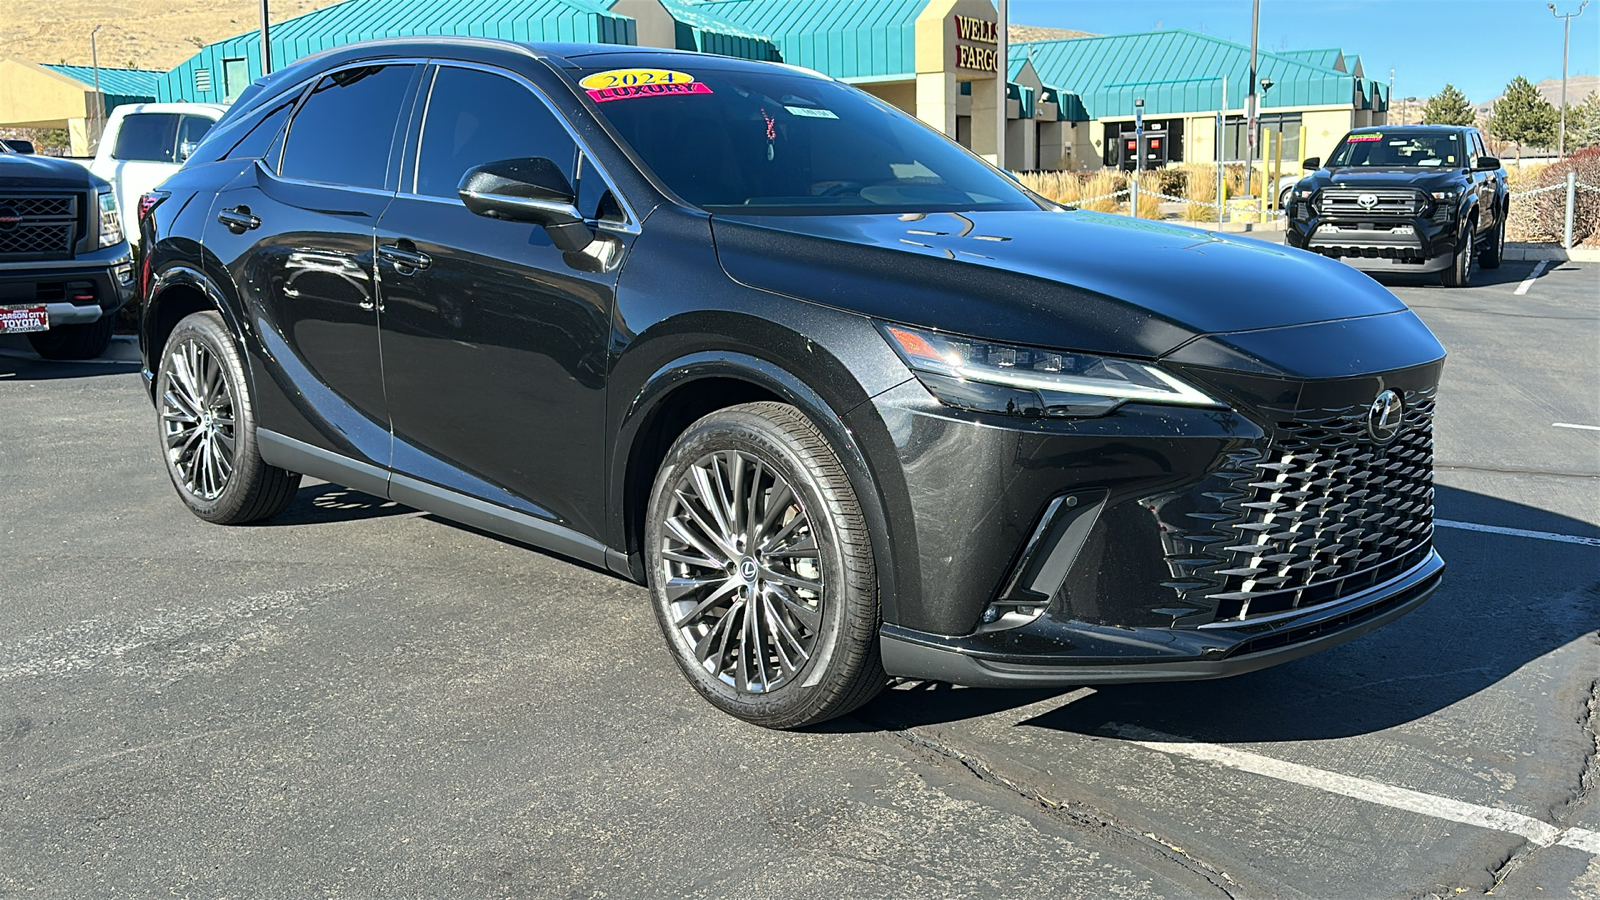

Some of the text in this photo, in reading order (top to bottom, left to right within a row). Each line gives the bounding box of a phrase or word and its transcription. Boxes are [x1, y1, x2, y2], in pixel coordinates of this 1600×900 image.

[604, 72, 676, 88] 2024
[598, 83, 695, 99] LUXURY
[2, 318, 42, 328] TOYOTA
